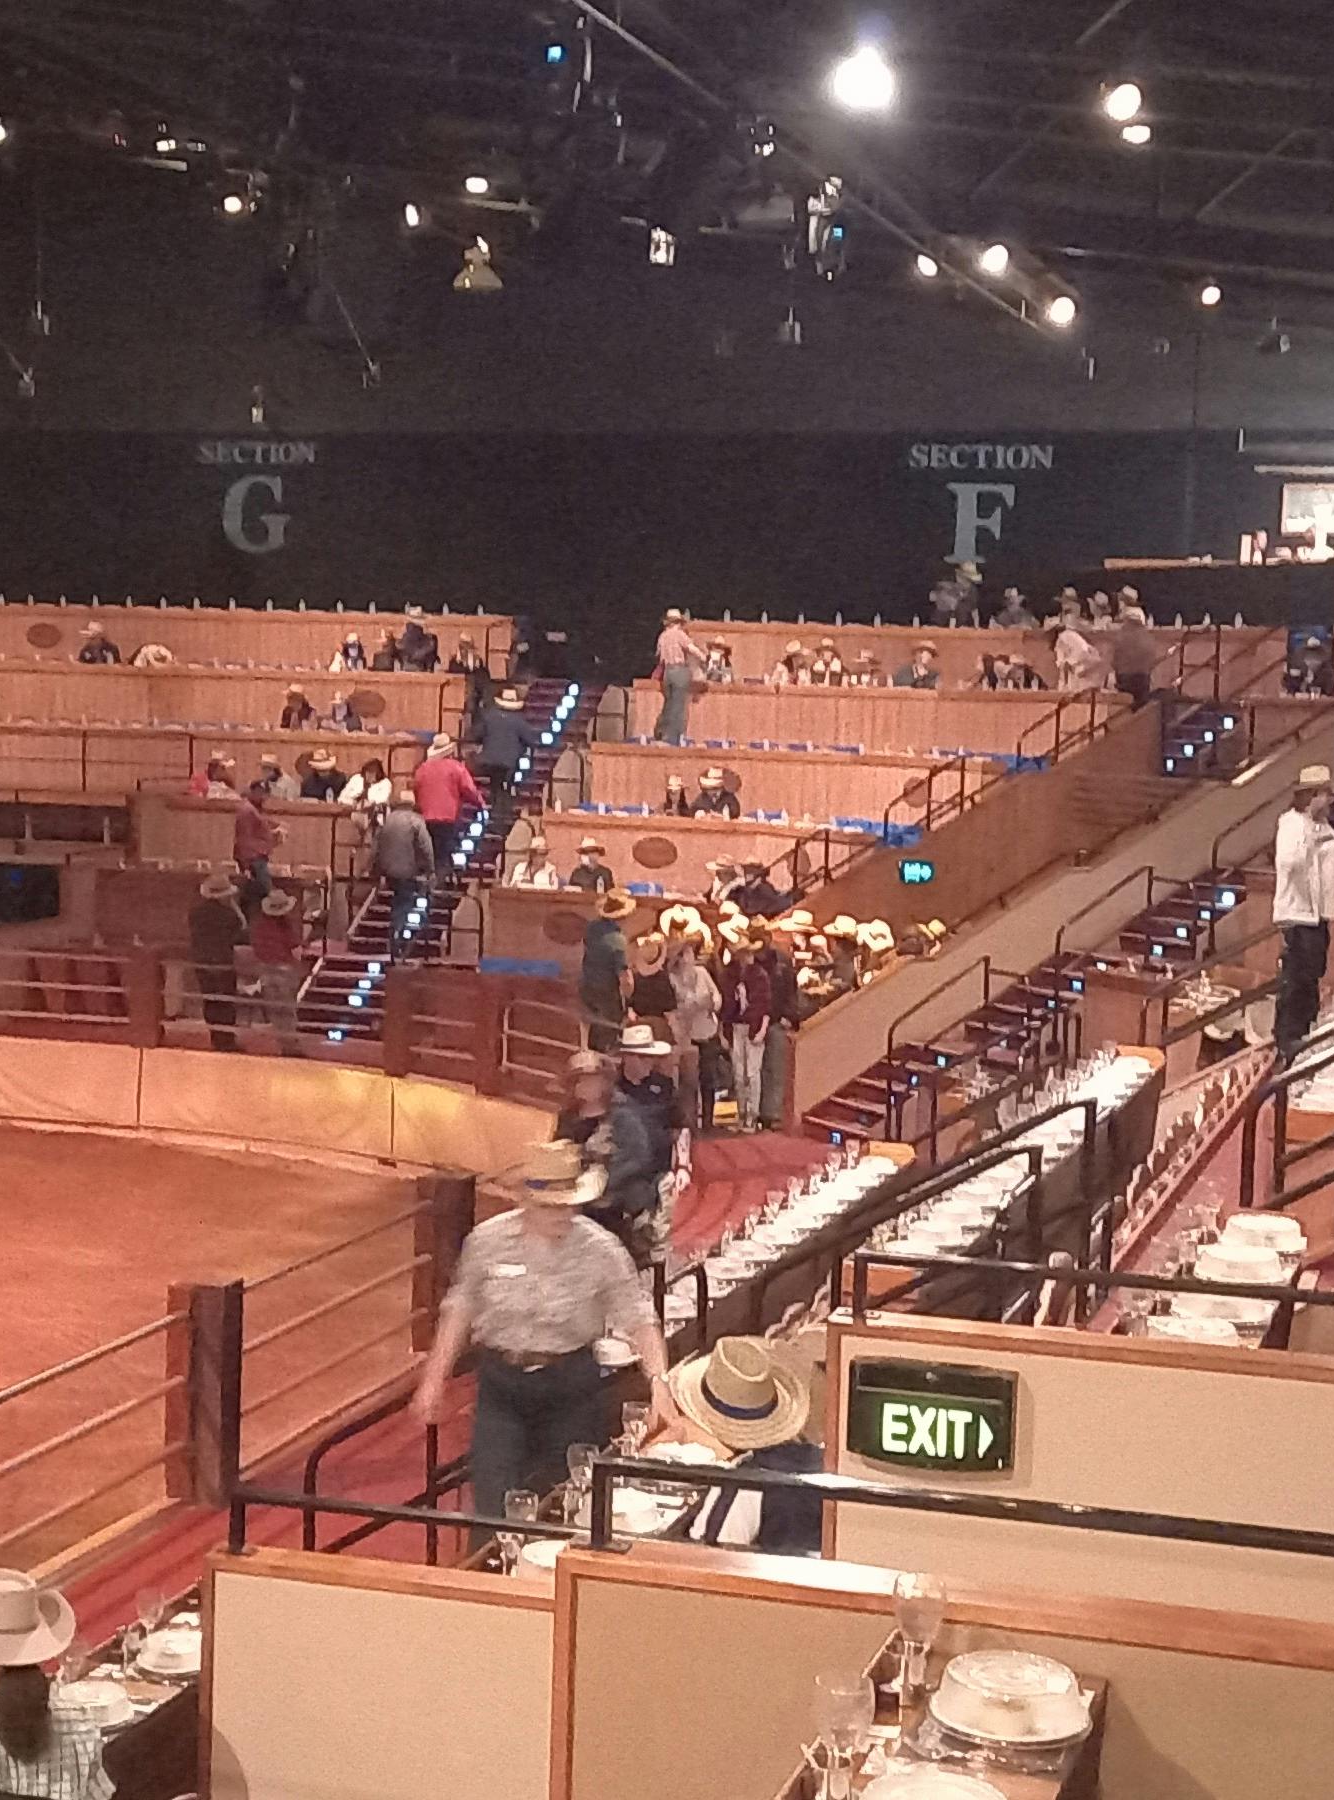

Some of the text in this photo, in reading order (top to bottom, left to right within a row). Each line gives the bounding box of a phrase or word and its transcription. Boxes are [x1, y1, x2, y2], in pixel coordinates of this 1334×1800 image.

[197, 441, 314, 464] SECTION
[908, 443, 1053, 469] SECTION
[222, 474, 291, 554] G
[943, 482, 1015, 563] F
[882, 1402, 973, 1460] EXIT
